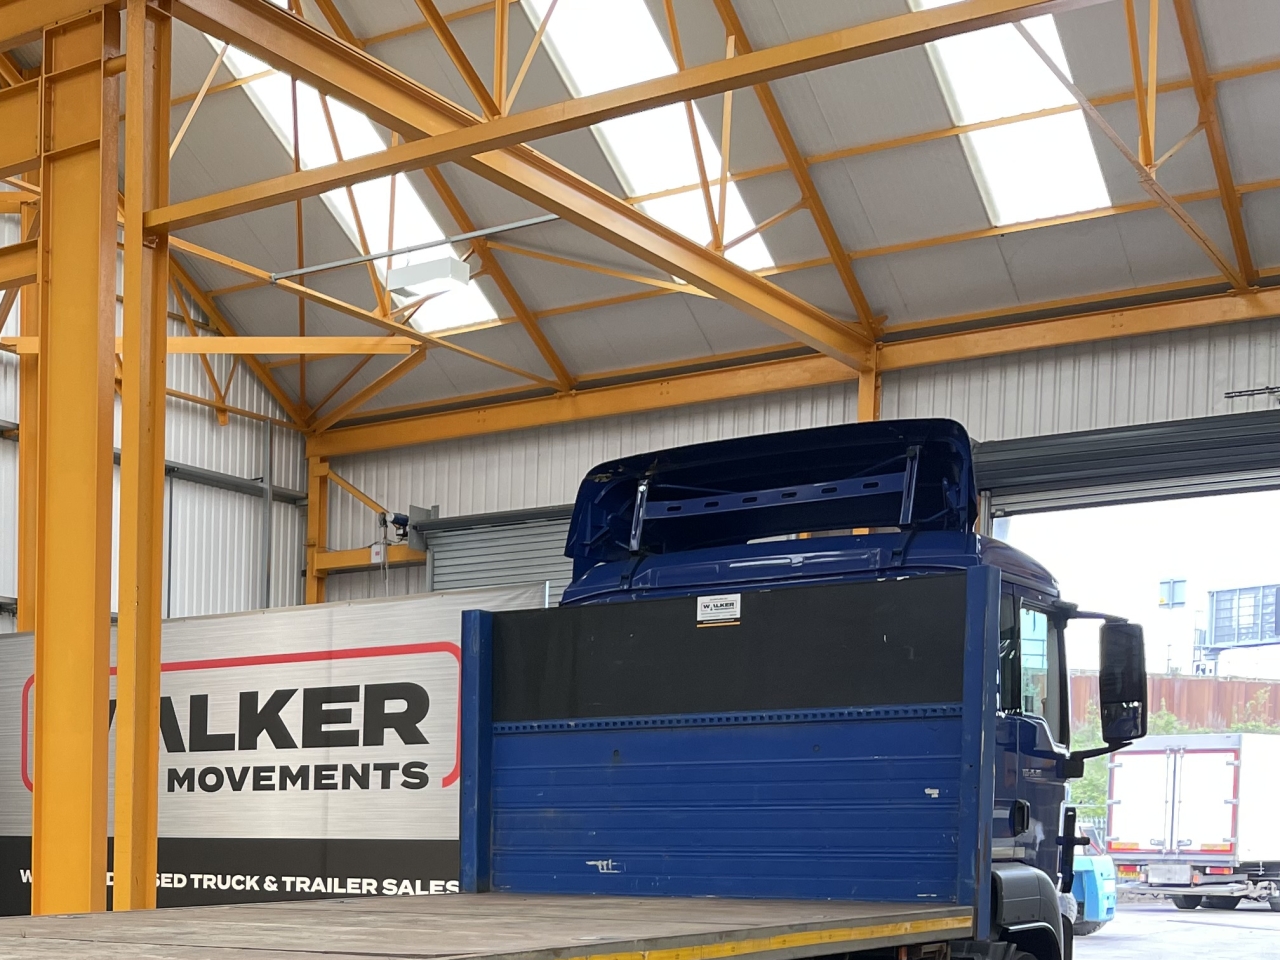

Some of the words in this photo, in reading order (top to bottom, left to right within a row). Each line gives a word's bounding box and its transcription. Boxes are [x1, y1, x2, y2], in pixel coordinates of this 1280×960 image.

[166, 761, 430, 793] MOVEMENTS
[189, 873, 261, 891] TRUCK
[263, 875, 279, 892] &
[281, 876, 378, 895] TRAILER
[381, 878, 460, 896] SALES
